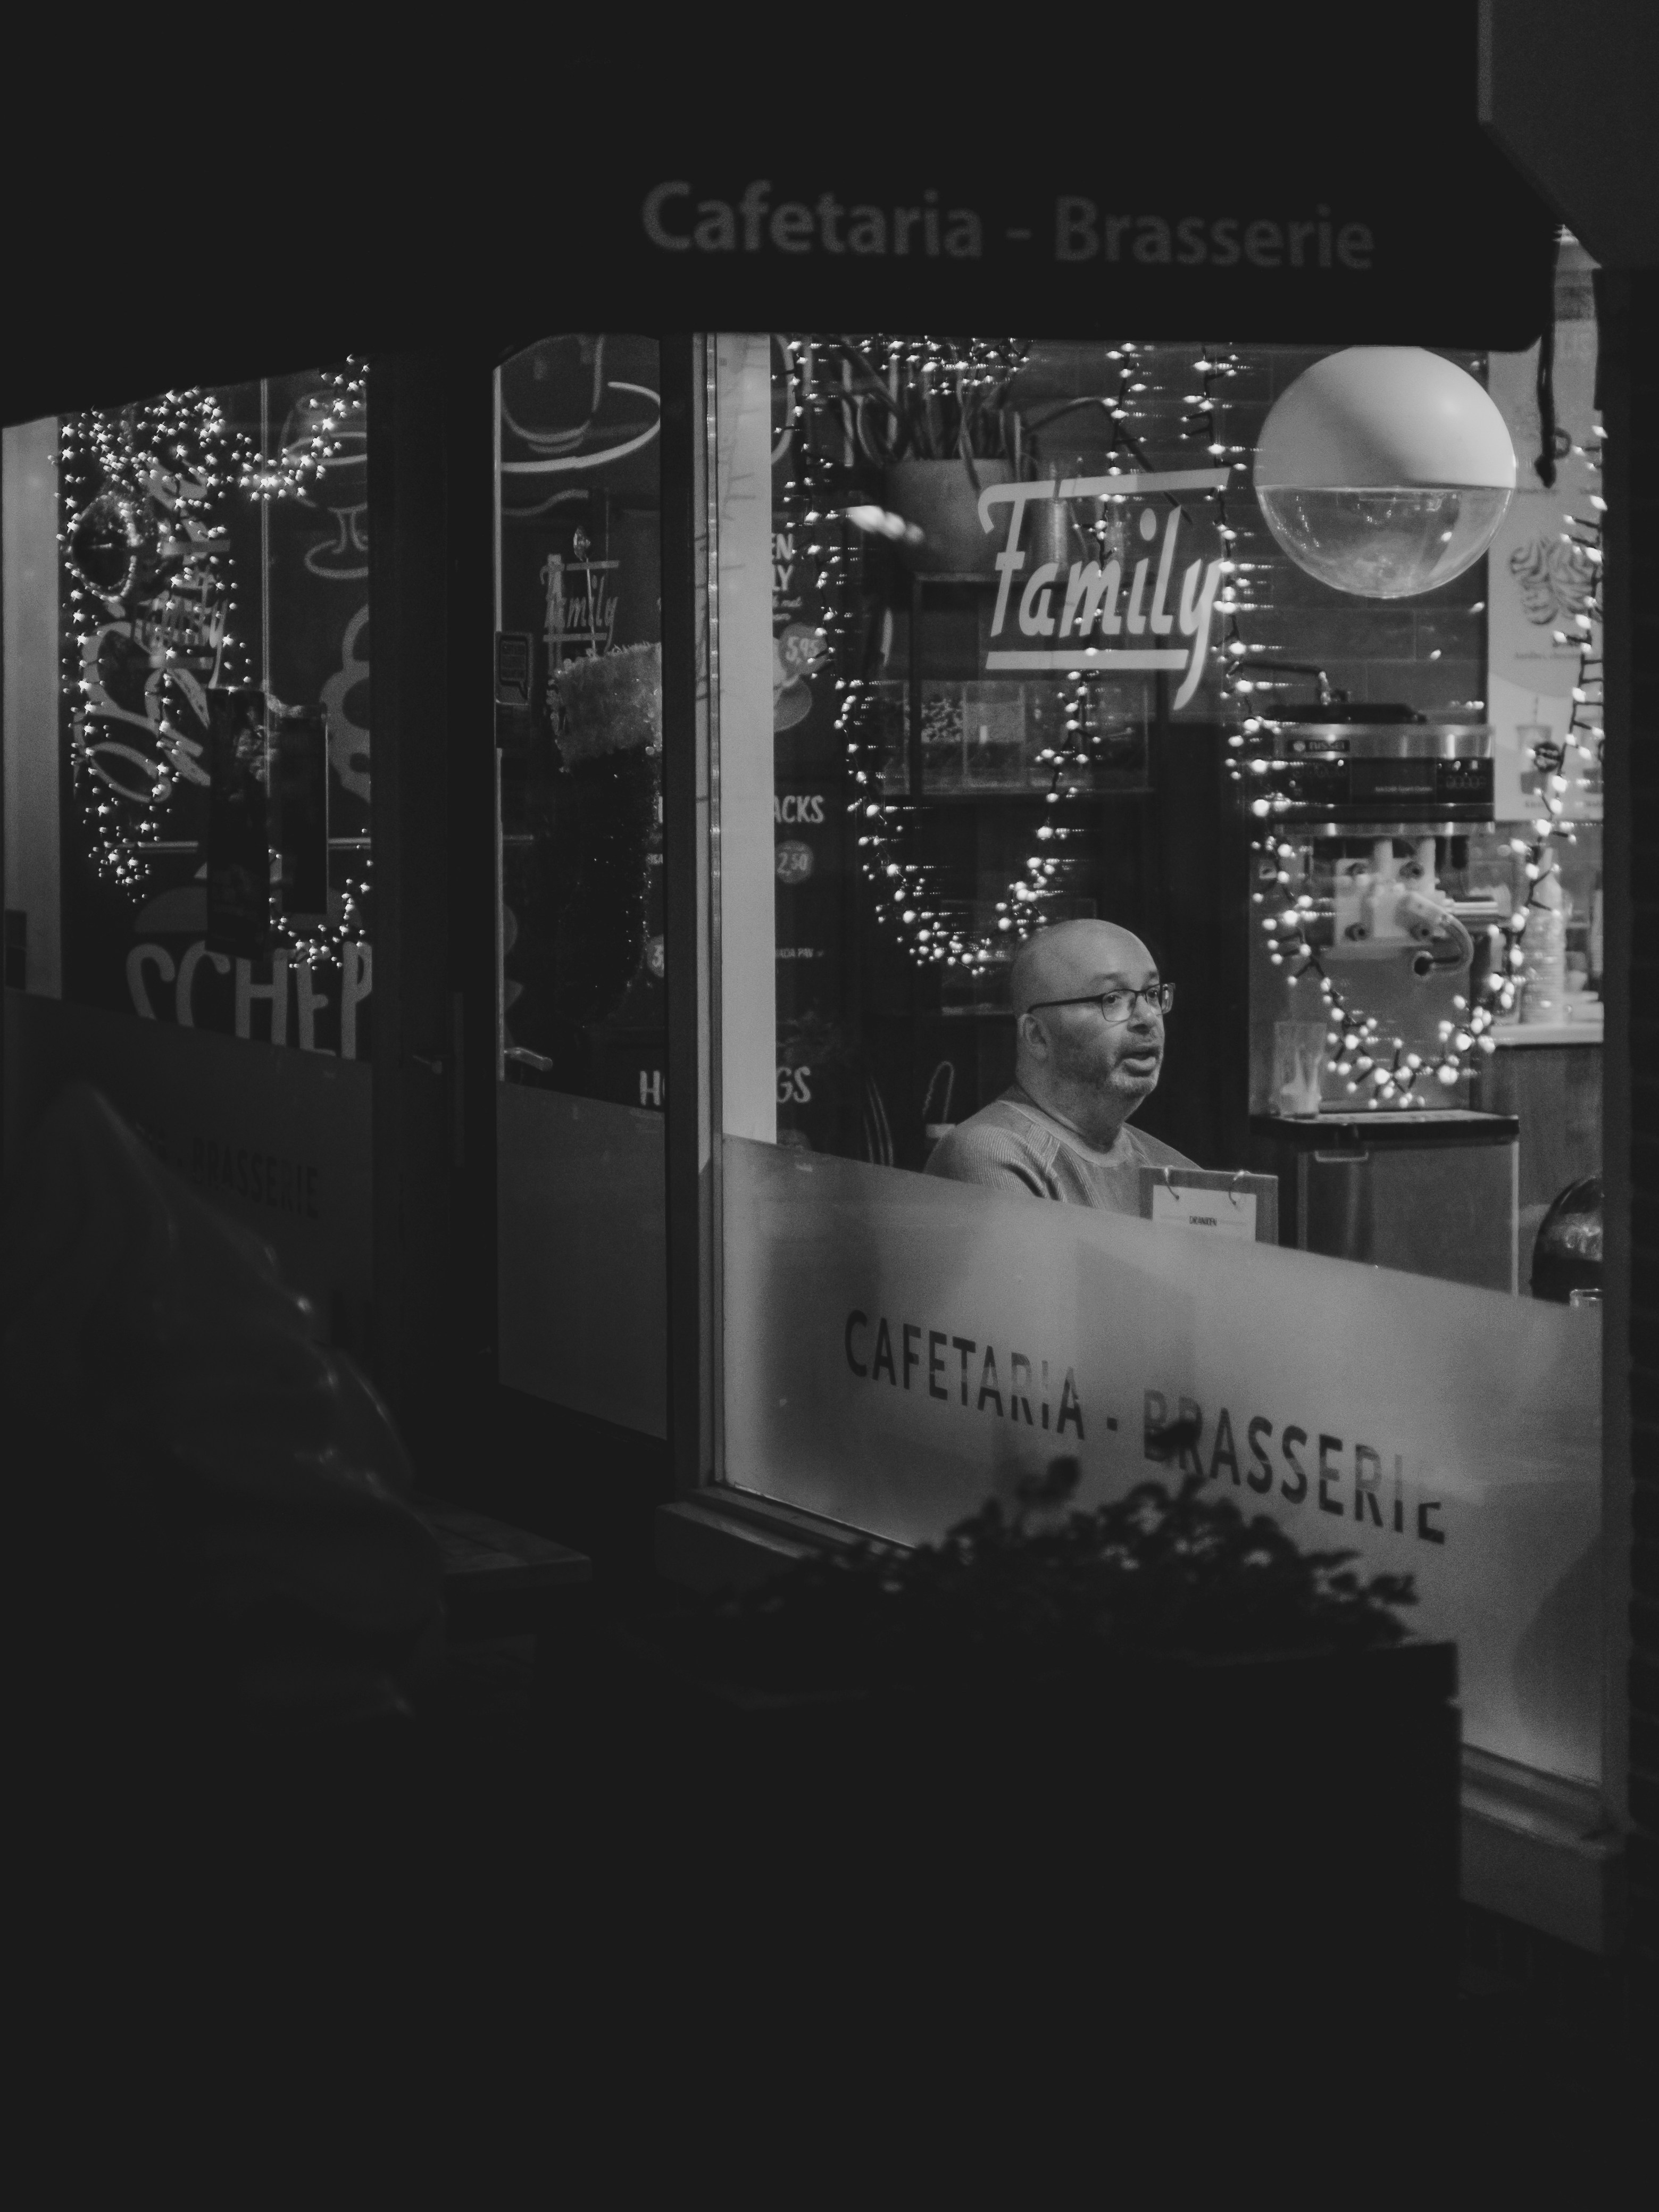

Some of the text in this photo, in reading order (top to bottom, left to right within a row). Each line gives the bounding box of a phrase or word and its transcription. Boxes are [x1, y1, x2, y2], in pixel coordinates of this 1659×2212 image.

[641, 178, 984, 260] Cafetaria
[1053, 193, 1377, 270] Brasserie
[978, 466, 1231, 711] Family
[192, 1136, 319, 1220] BRASSERIE
[844, 1309, 1085, 1440] CAFETARIA
[1143, 1389, 1445, 1545] BRASSERIE
